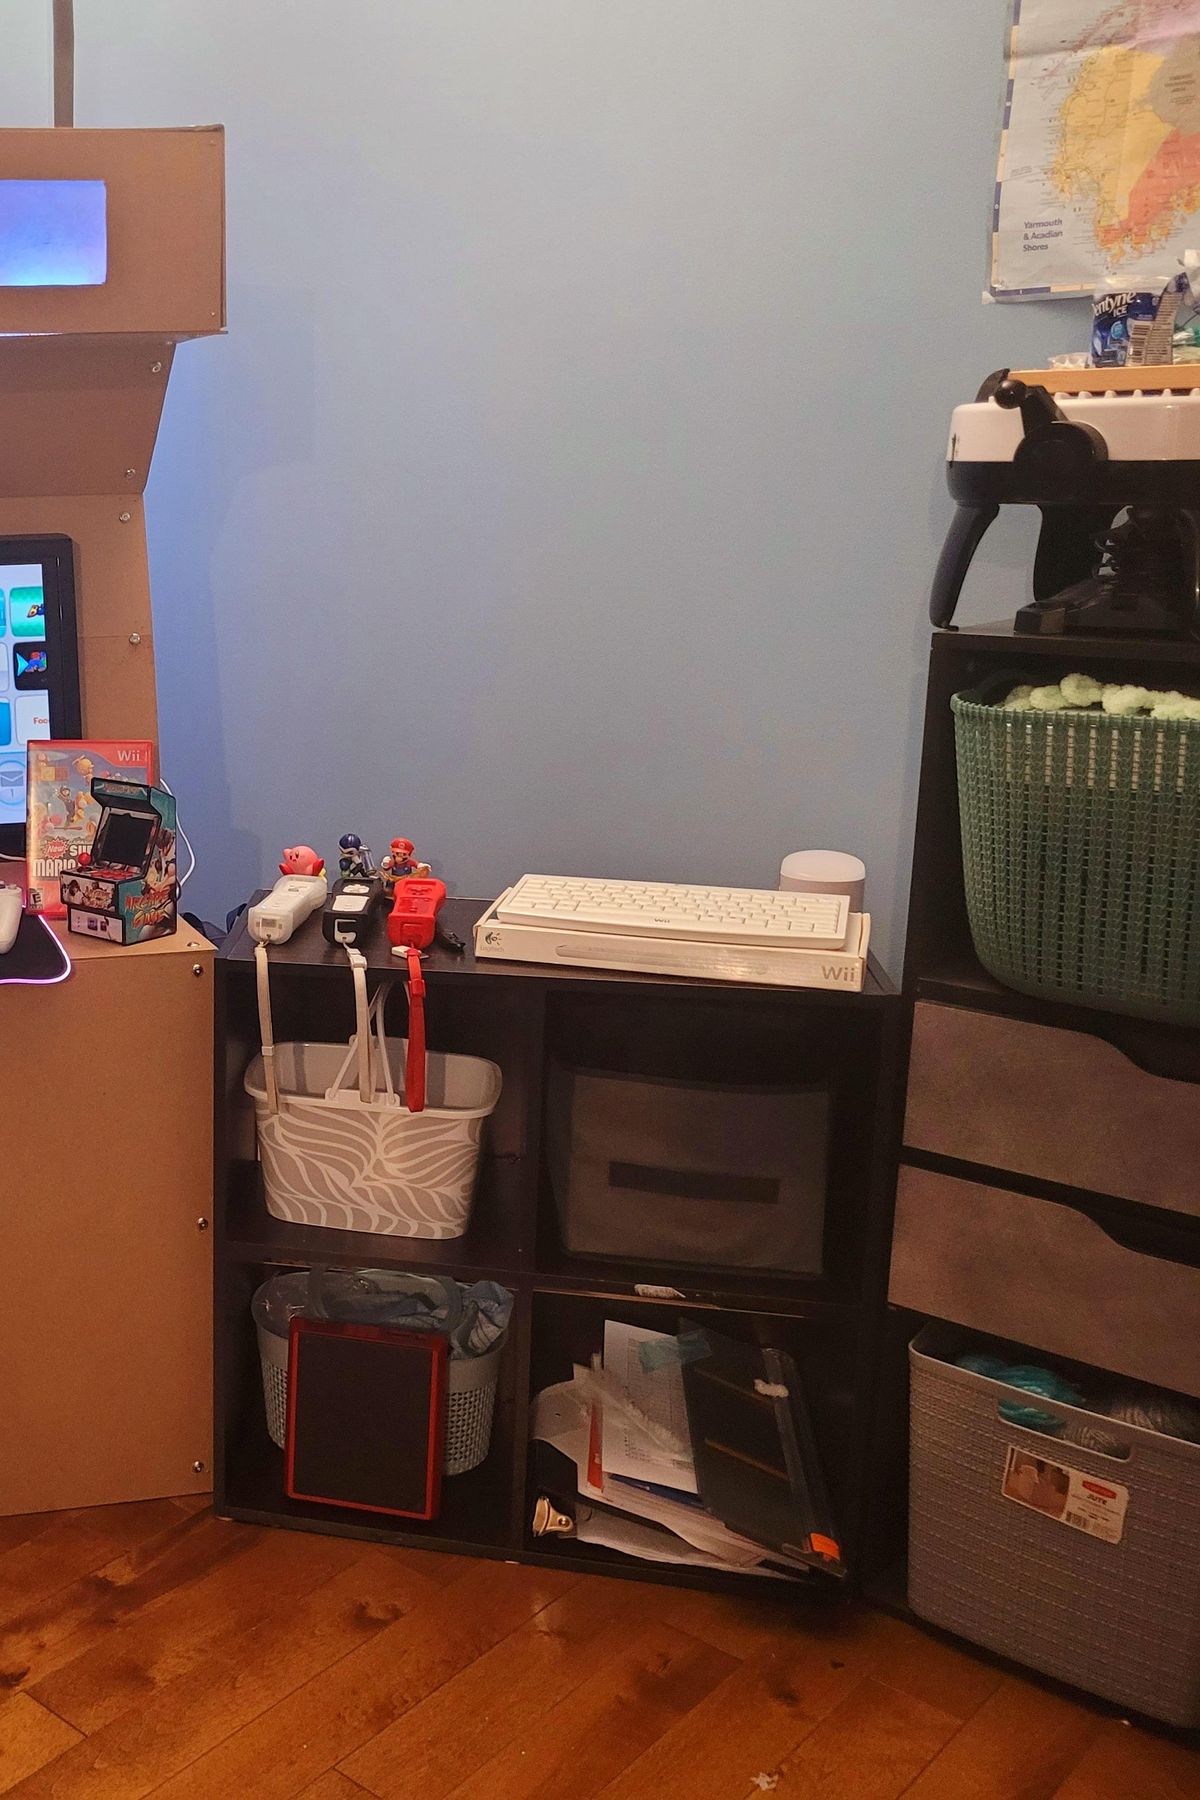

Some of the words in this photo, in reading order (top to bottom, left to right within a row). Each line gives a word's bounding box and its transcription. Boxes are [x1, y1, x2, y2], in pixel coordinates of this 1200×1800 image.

[1024, 218, 1063, 229] Yarmouth
[1031, 230, 1063, 240] Acadian
[1023, 244, 1048, 252] Shores
[1113, 305, 1128, 317] ICE
[117, 750, 140, 762] Wii
[47, 845, 65, 853] New
[822, 966, 855, 982] Wii
